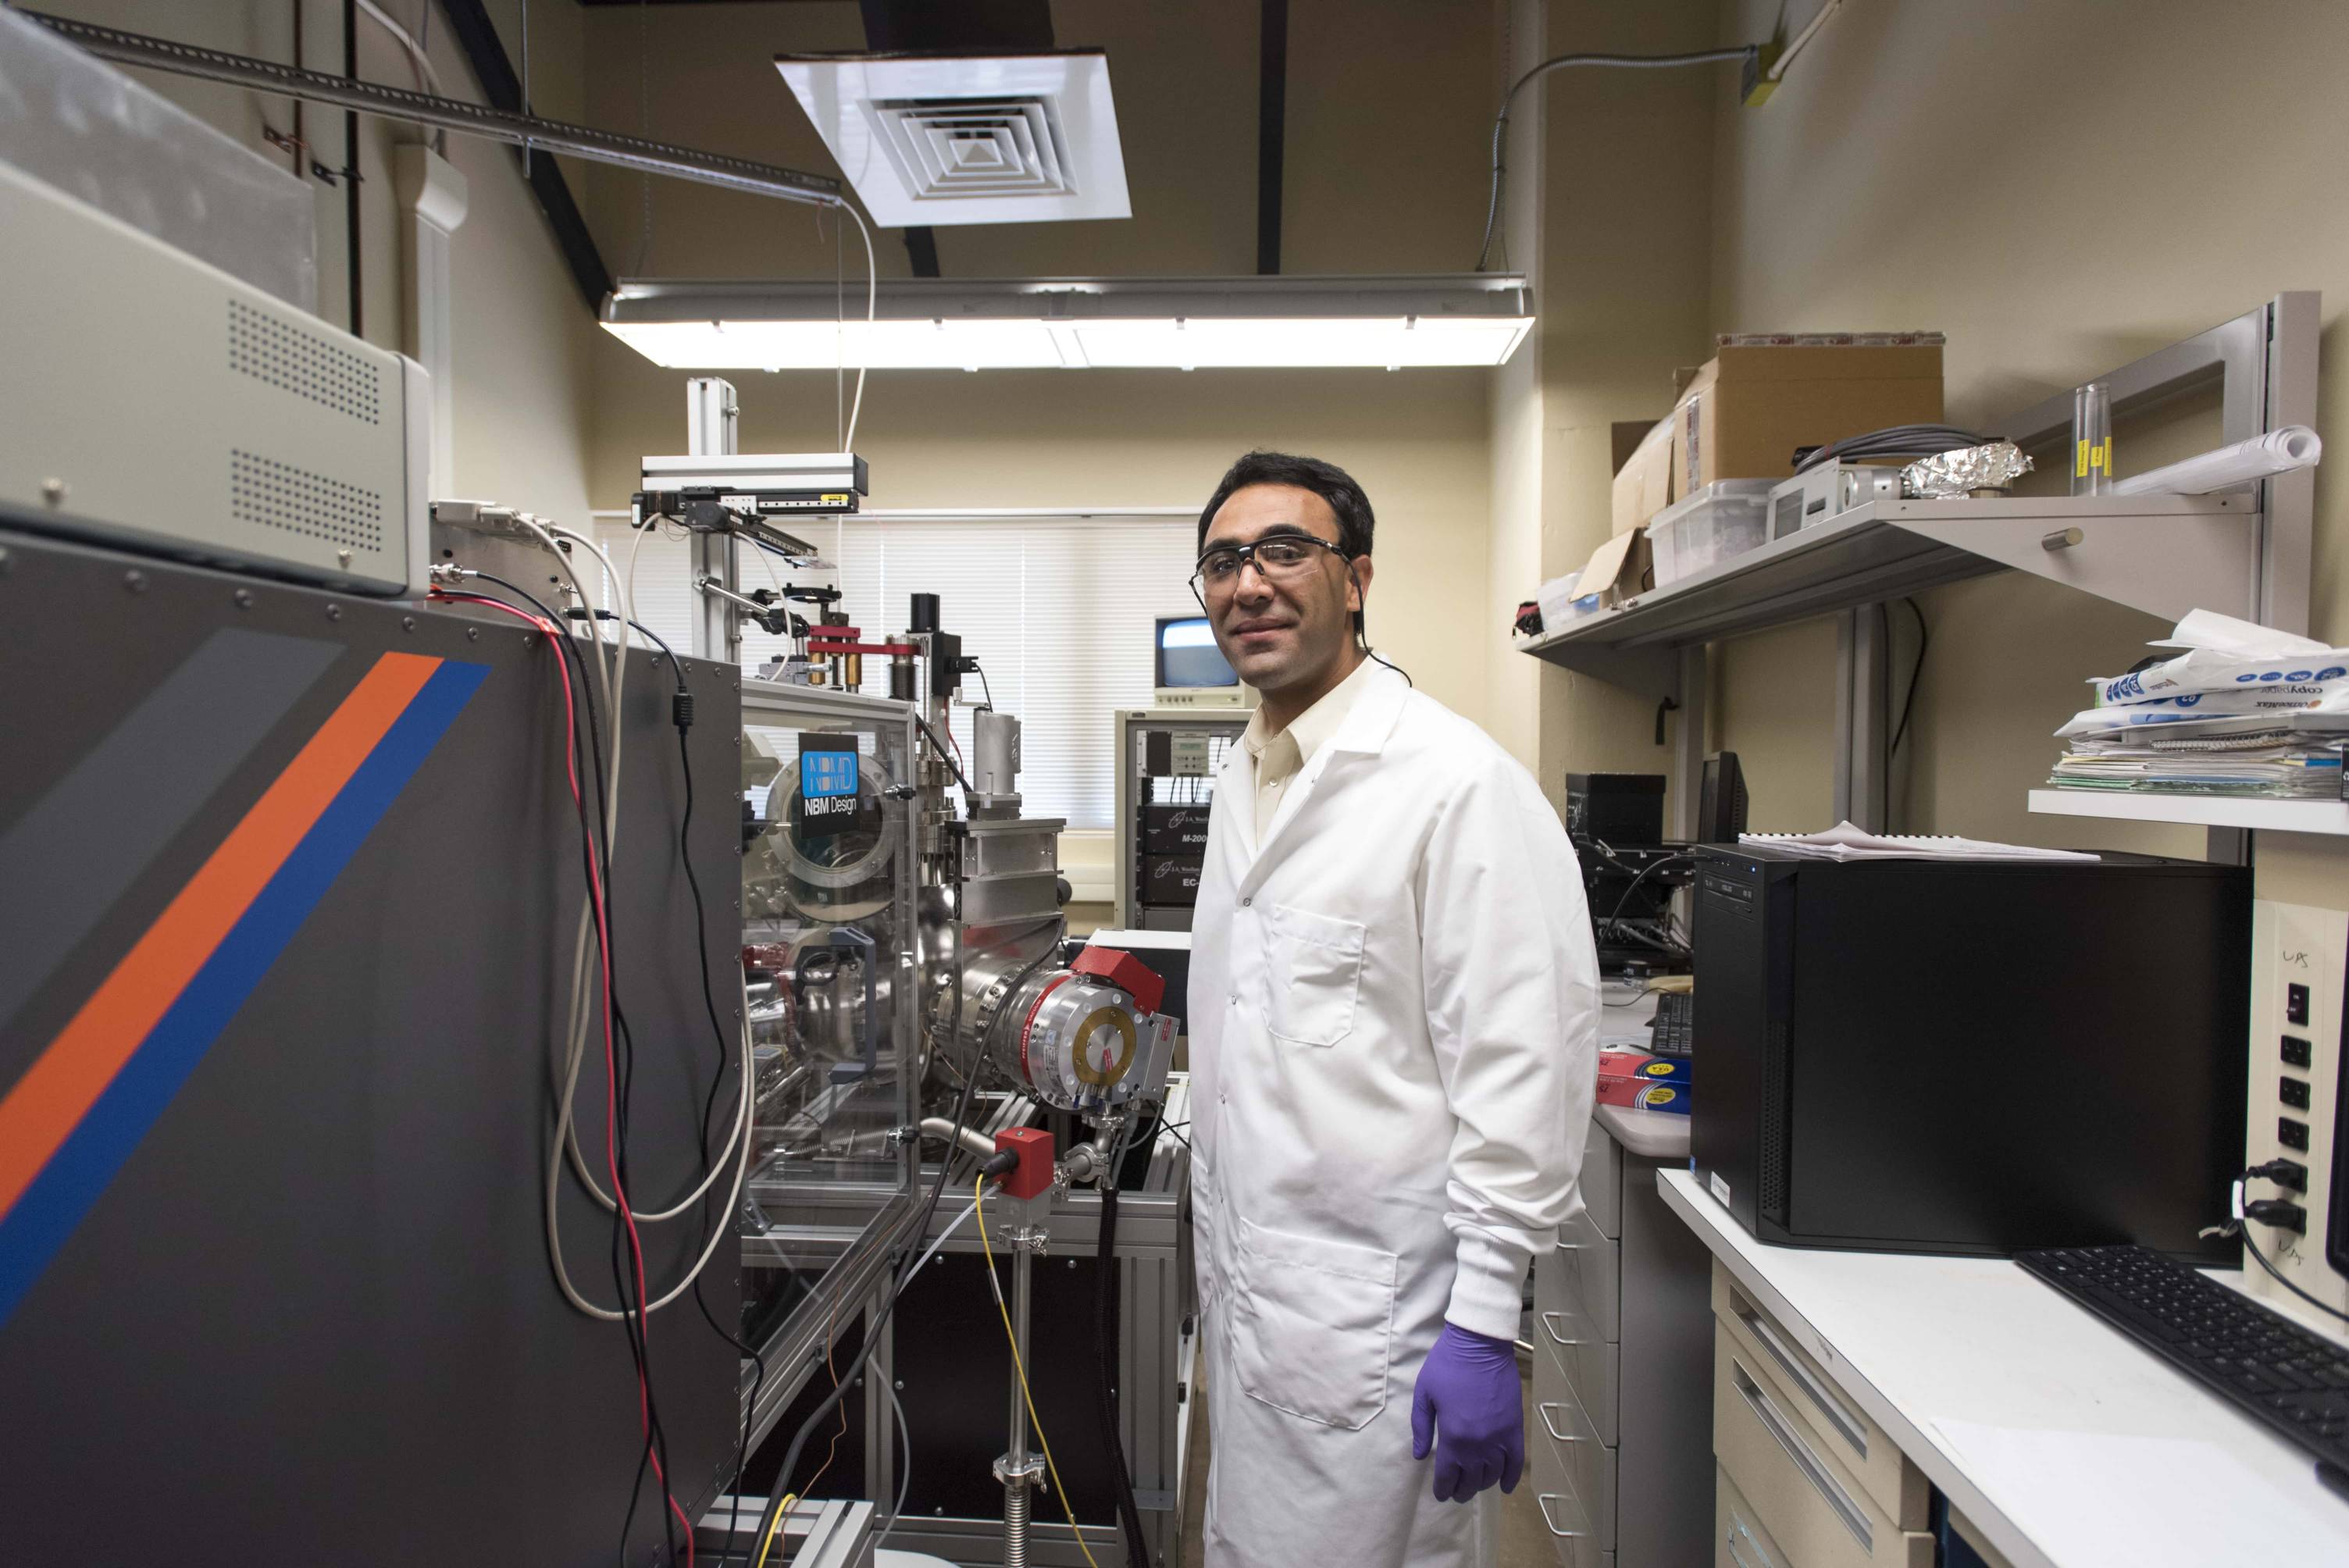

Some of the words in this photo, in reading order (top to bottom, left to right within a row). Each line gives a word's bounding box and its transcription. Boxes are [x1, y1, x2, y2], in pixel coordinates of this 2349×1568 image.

[804, 796, 829, 817] NBM
[831, 796, 857, 815] Design
[1028, 999, 1042, 1021] VACUUM
